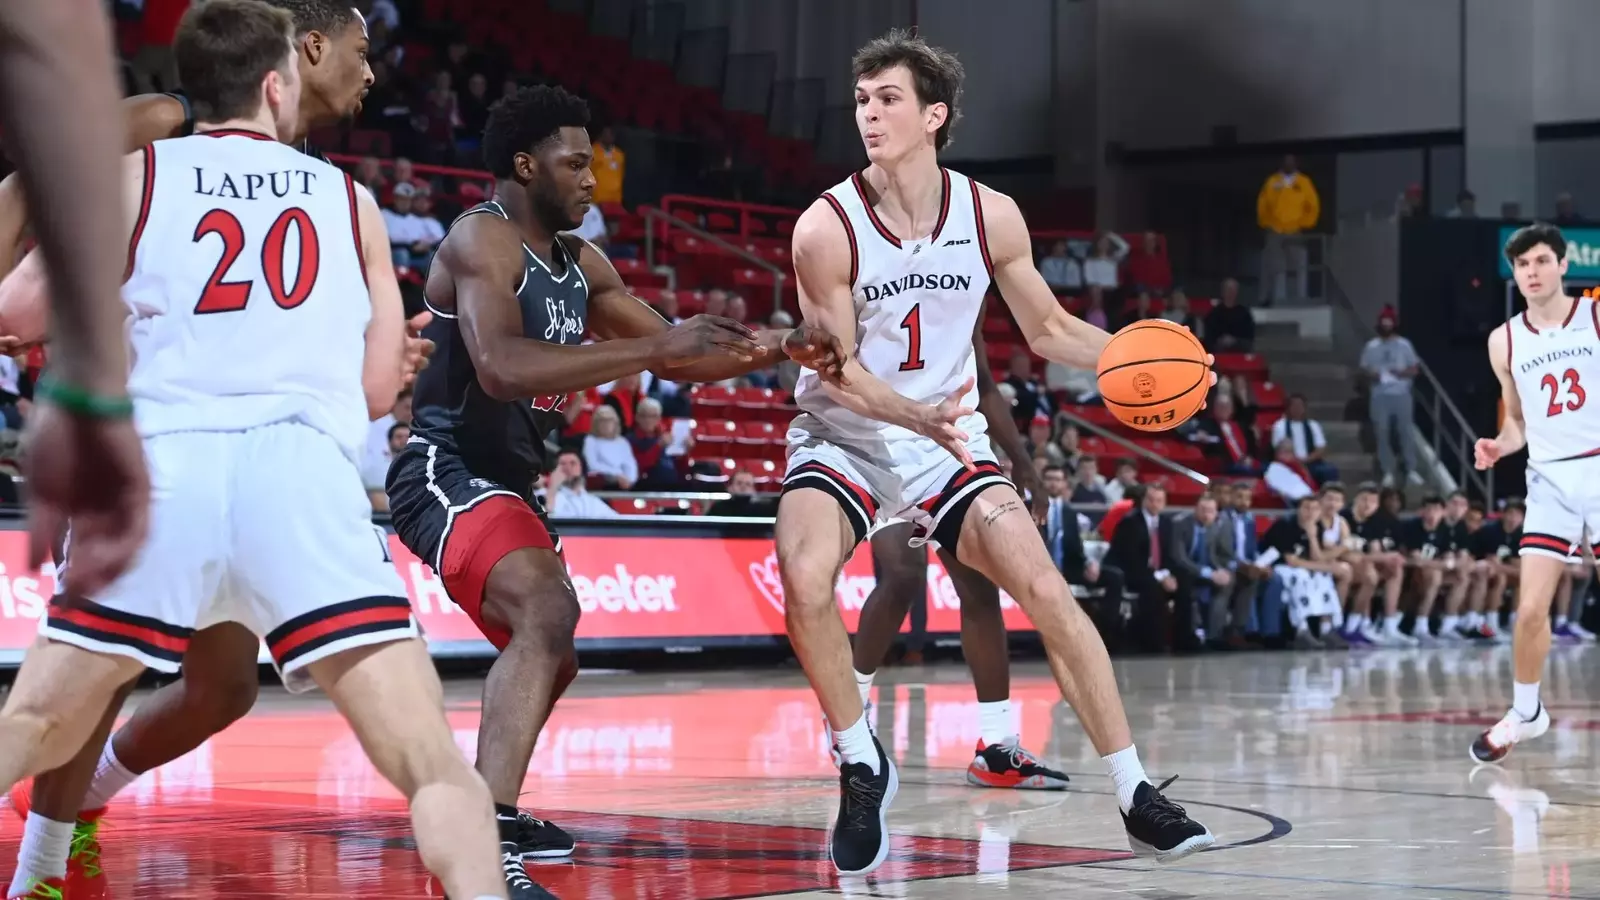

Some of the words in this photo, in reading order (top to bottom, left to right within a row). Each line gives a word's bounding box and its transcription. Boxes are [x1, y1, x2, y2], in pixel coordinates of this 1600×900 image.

[193, 166, 317, 200] LAPUT
[192, 206, 320, 315] 20
[862, 273, 971, 302] DAVIDSON
[898, 302, 925, 371] 1
[1521, 345, 1593, 373] DAVIDSON
[1540, 368, 1586, 417] 23
[1133, 408, 1175, 425] EVO
[566, 563, 677, 612] eeter
